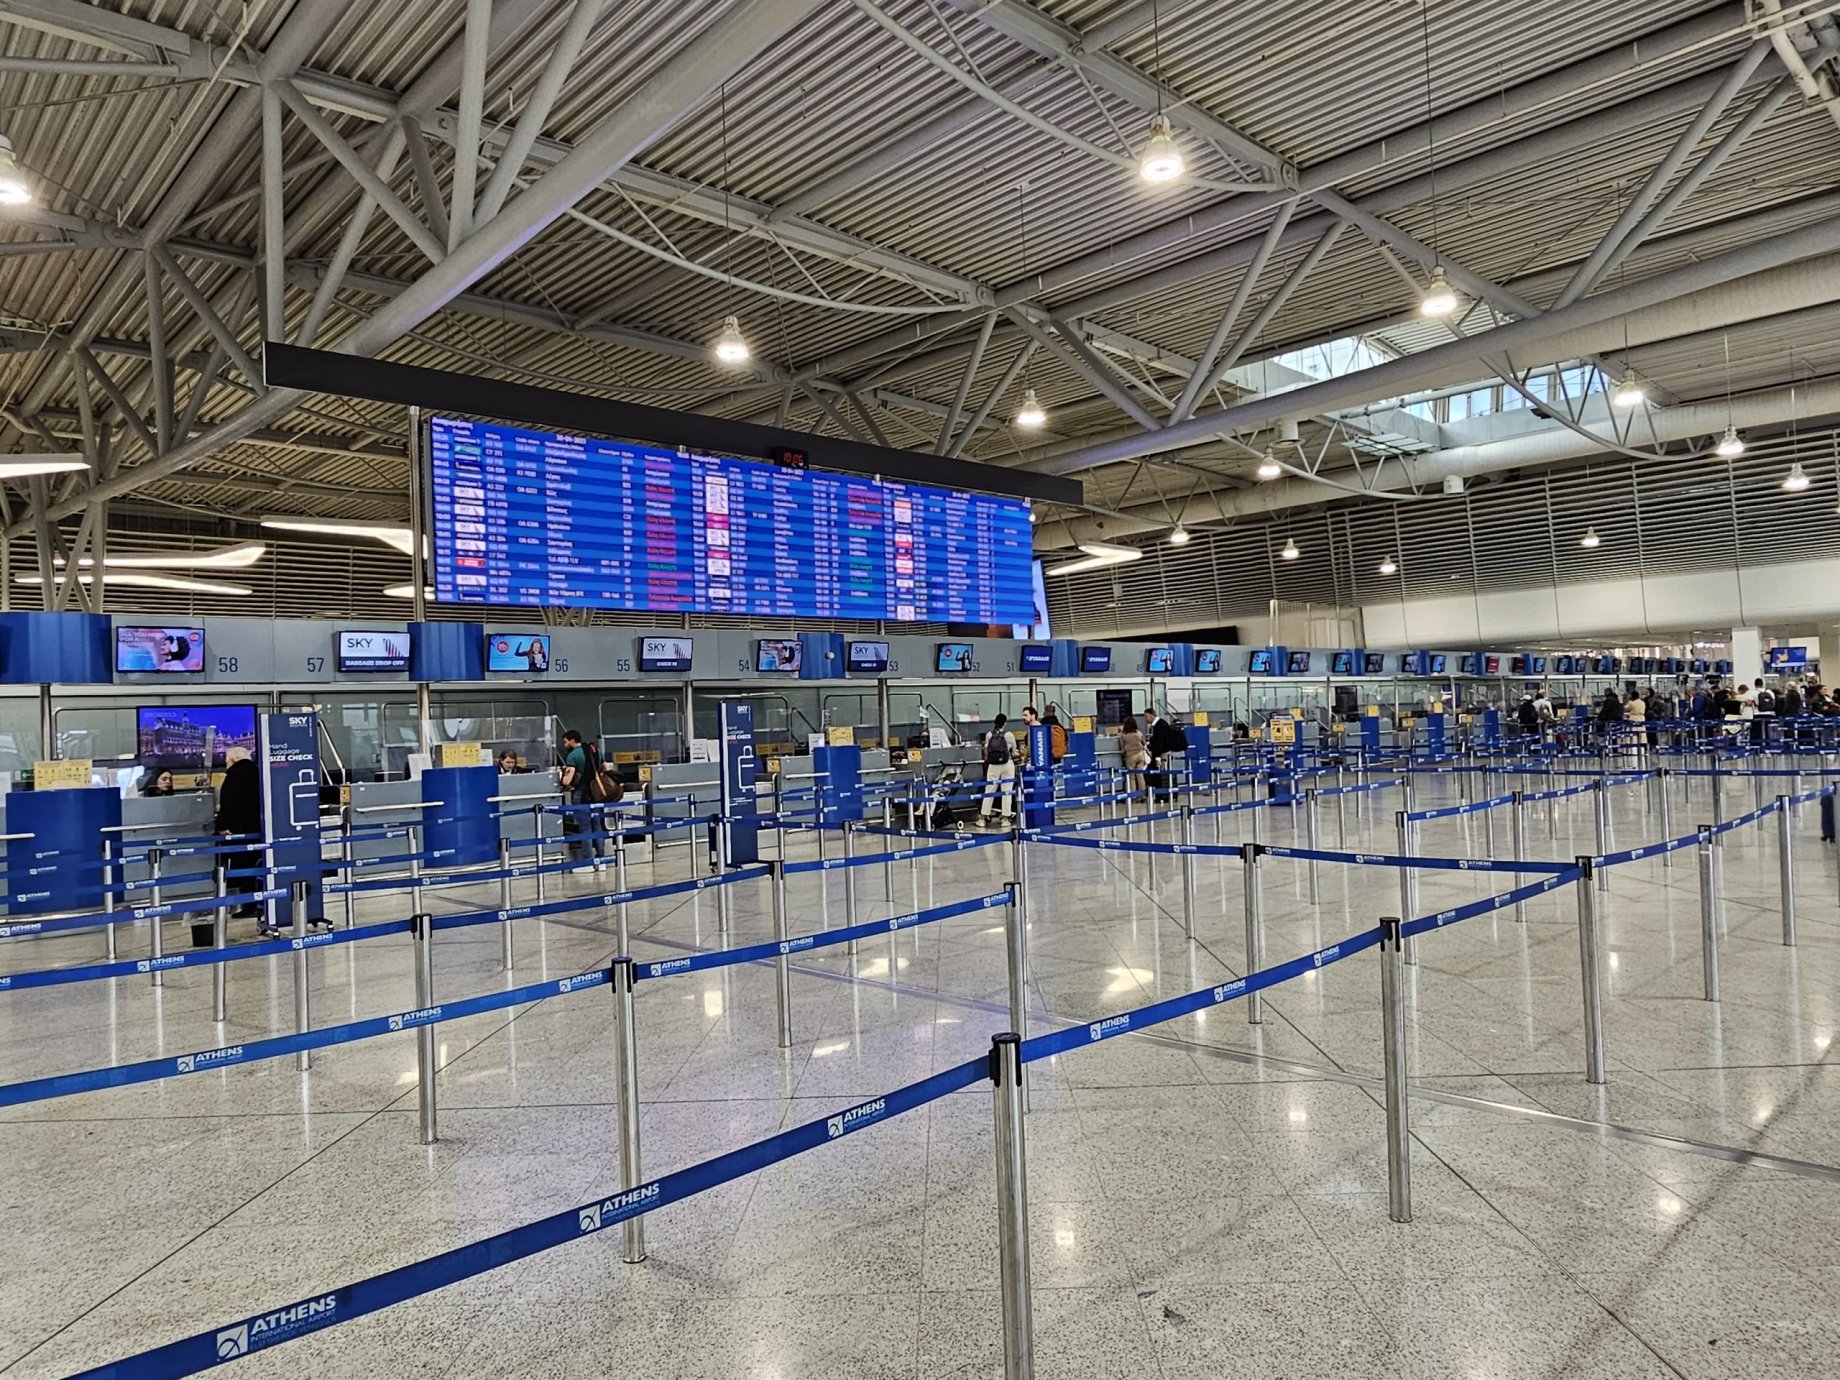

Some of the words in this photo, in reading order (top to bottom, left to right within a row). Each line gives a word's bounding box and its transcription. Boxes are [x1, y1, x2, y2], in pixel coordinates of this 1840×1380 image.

[347, 638, 373, 648] SKY
[648, 643, 666, 652] SKY
[854, 646, 869, 655] SKY
[218, 657, 238, 672] 58
[307, 658, 324, 672] 57
[555, 659, 568, 672] 56
[617, 659, 630, 672] 55
[739, 660, 750, 672] 54
[889, 661, 898, 672] 53
[972, 662, 980, 672] 52
[1007, 662, 1014, 672] 51
[289, 716, 308, 724] SKY
[263, 888, 287, 896] ATHENS
[990, 893, 1009, 902] ATHENS
[898, 914, 919, 924] ATHENS
[11, 923, 41, 932] ATHENS
[304, 933, 333, 943] ATHENS
[789, 937, 814, 948] ATHENS
[1321, 946, 1340, 958] ATHENS
[151, 956, 184, 965] ATHENS
[661, 959, 690, 969] ATHENS
[571, 971, 602, 984] ATHENS
[1223, 979, 1246, 992] ATHENS
[404, 1007, 442, 1020] ATHENS
[1101, 1014, 1130, 1030] ATHENS
[196, 1046, 243, 1062] ATHENS
[844, 1099, 886, 1122] ATHENS
[602, 1183, 660, 1214] ATHENS
[602, 1203, 639, 1219] INTERNATIONAL
[640, 1194, 659, 1205] AIRPORT
[251, 1295, 336, 1335] ATHENS
[250, 1320, 306, 1342] INTERNATIONAL
[308, 1308, 336, 1323] AIRPORT
